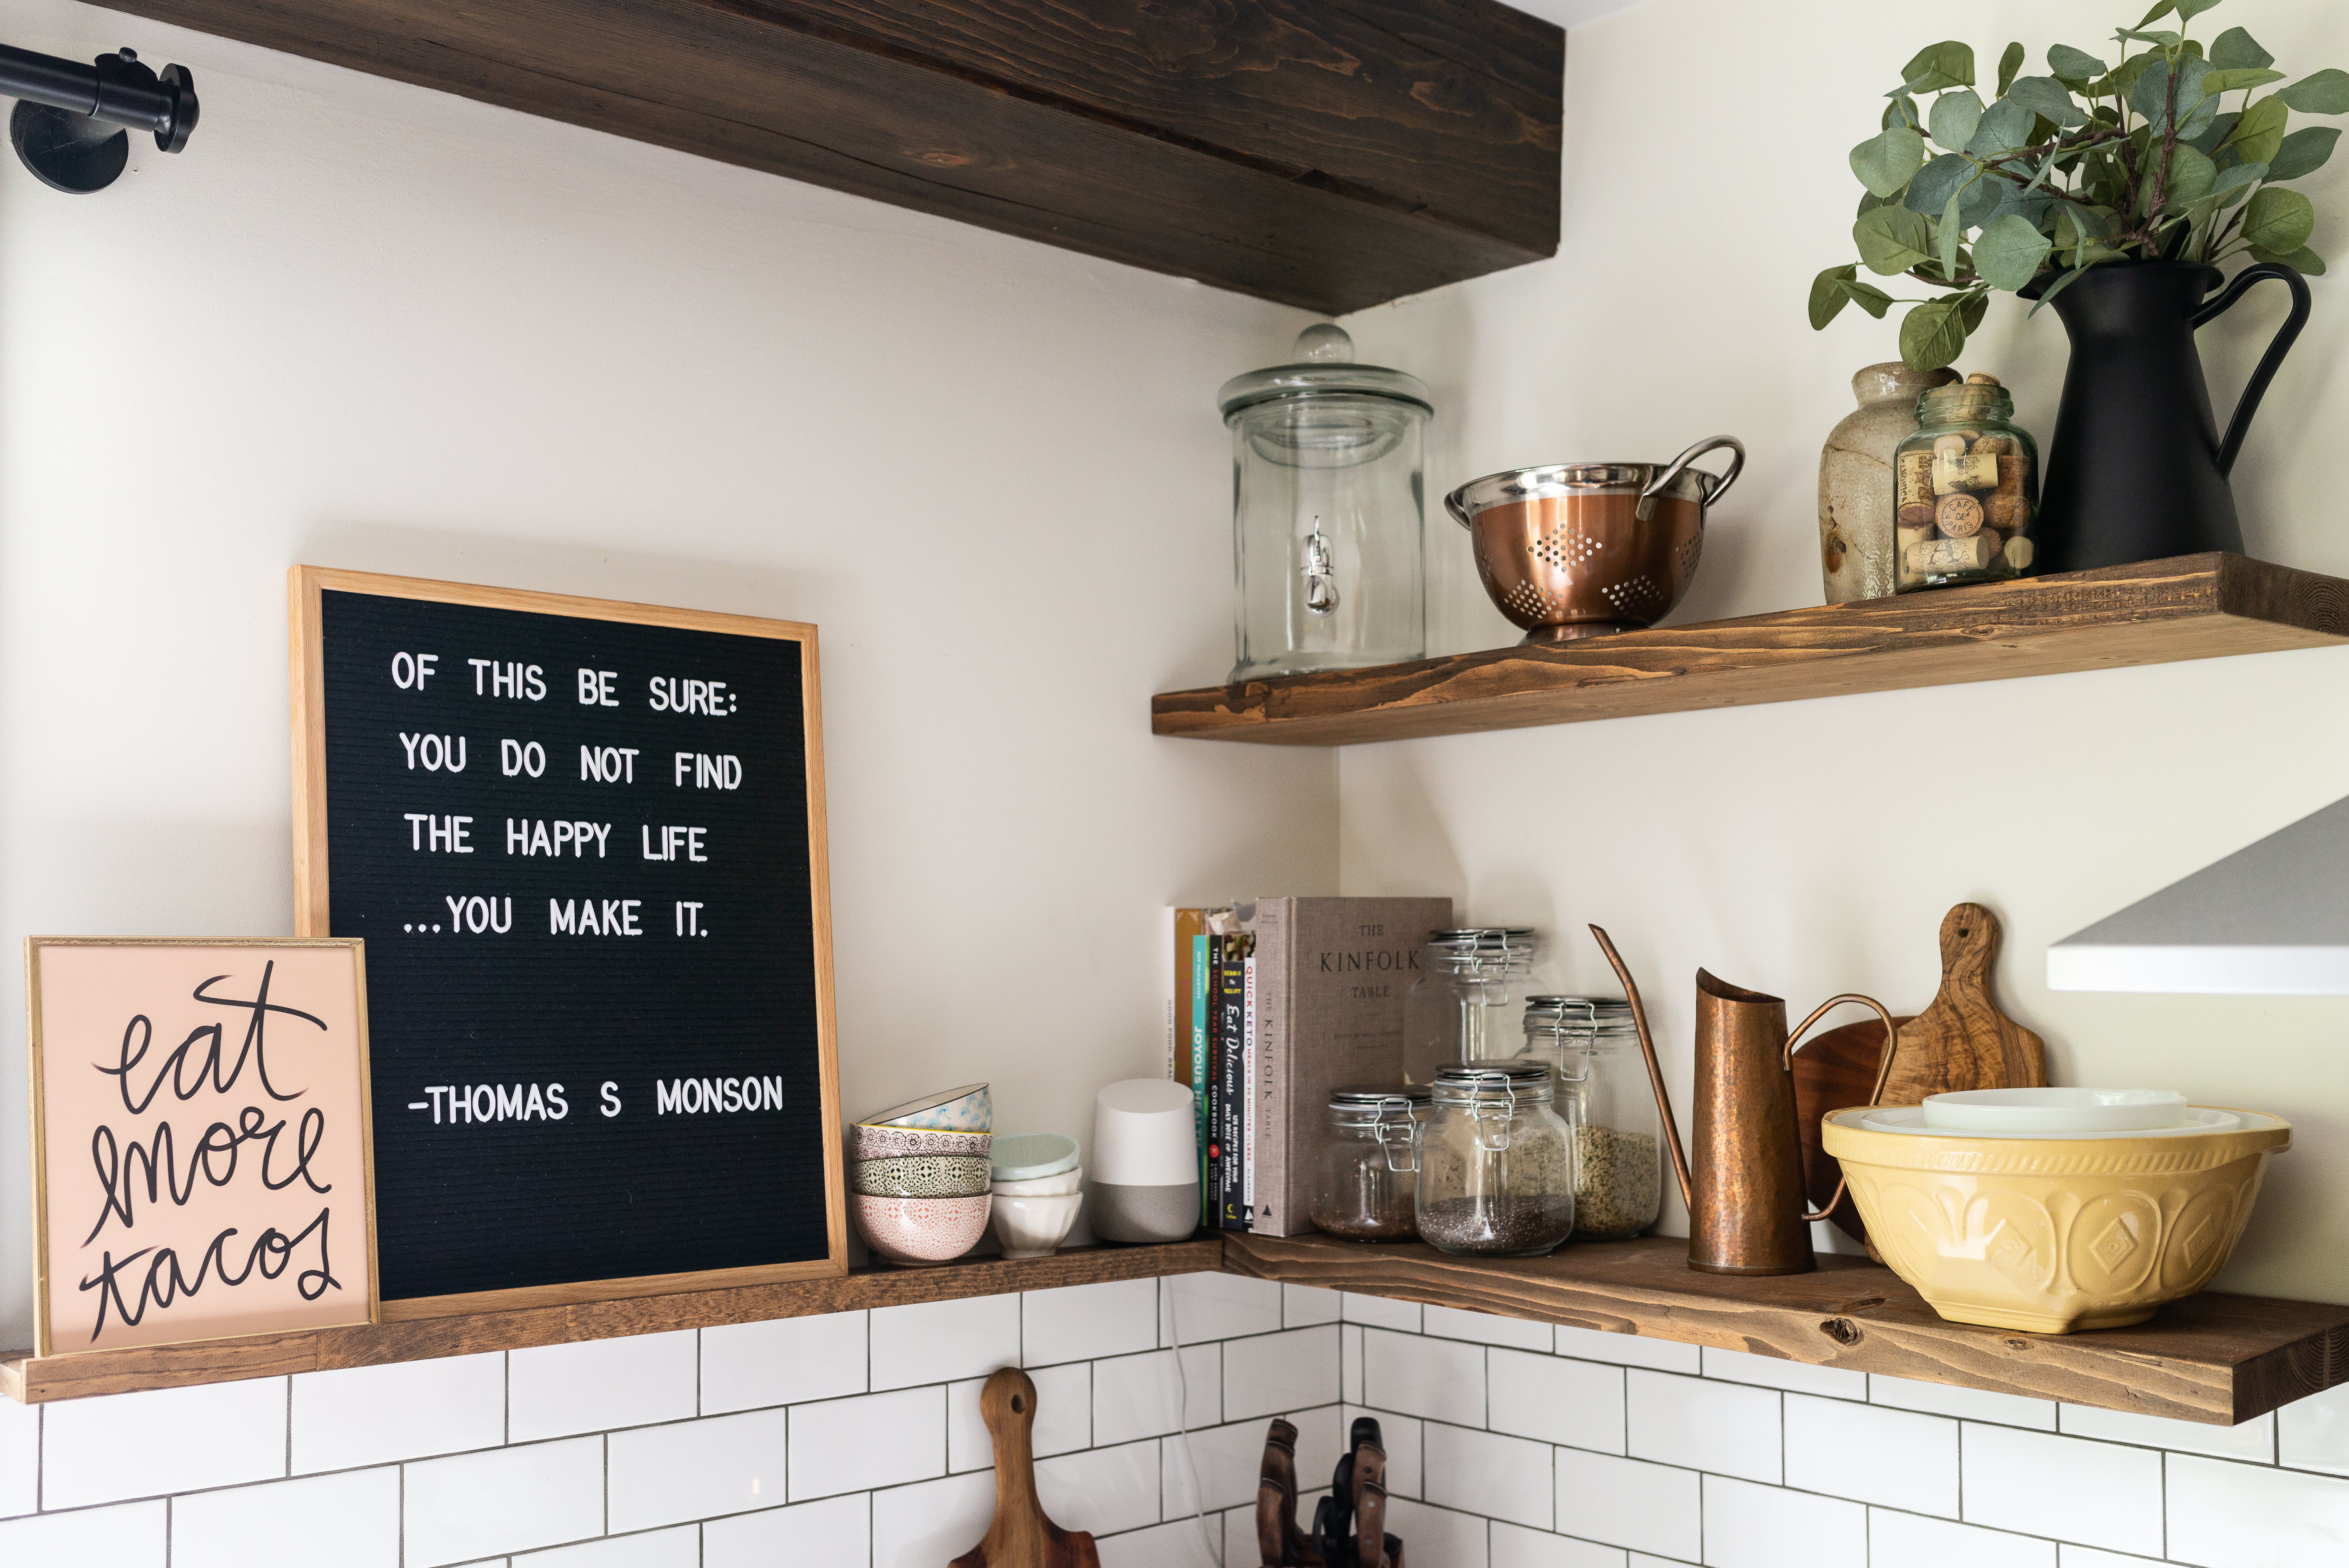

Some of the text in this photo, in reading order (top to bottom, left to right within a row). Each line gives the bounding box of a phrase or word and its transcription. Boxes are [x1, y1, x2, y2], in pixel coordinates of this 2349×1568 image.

[1945, 521, 1973, 533] PARIS
[392, 652, 736, 716] OF THIS BE SURE:
[399, 733, 742, 790] YOU DO NOT FIND
[404, 814, 707, 862] THE HAPPY LIFE
[550, 898, 642, 936] MAKE
[677, 901, 707, 937] IT.
[1359, 924, 1384, 936] THE
[1320, 951, 1420, 972] KINFOLK
[1351, 985, 1390, 998] TABLE
[96, 960, 327, 1114] eat
[1226, 1003, 1240, 1033] Eat
[1194, 1026, 1202, 1084] JOYOUS
[1225, 1037, 1240, 1096] Delicious
[1264, 1019, 1273, 1100] KINFOLK
[601, 1081, 621, 1117] S
[657, 1076, 782, 1115] MONSON
[79, 1106, 333, 1249] more
[79, 1207, 343, 1343] tacos
